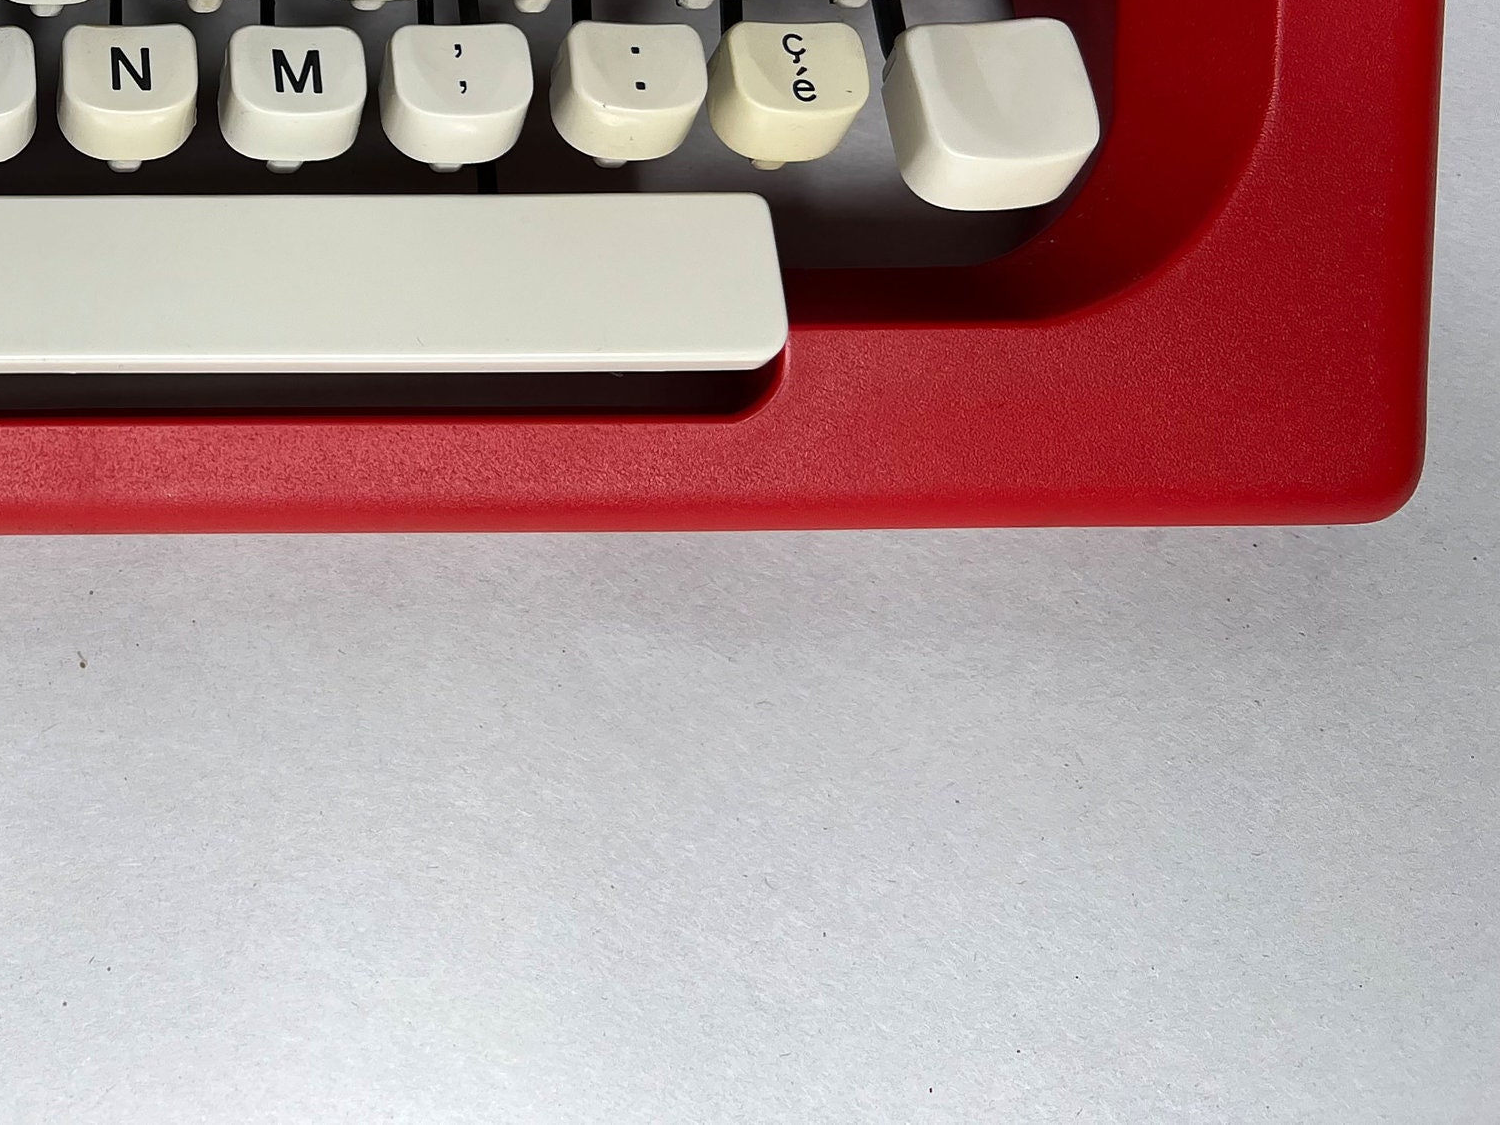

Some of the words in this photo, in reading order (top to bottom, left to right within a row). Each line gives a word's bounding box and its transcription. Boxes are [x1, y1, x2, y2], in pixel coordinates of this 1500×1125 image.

[110, 46, 152, 91] N
[271, 48, 323, 94] M
[792, 66, 817, 103] é
